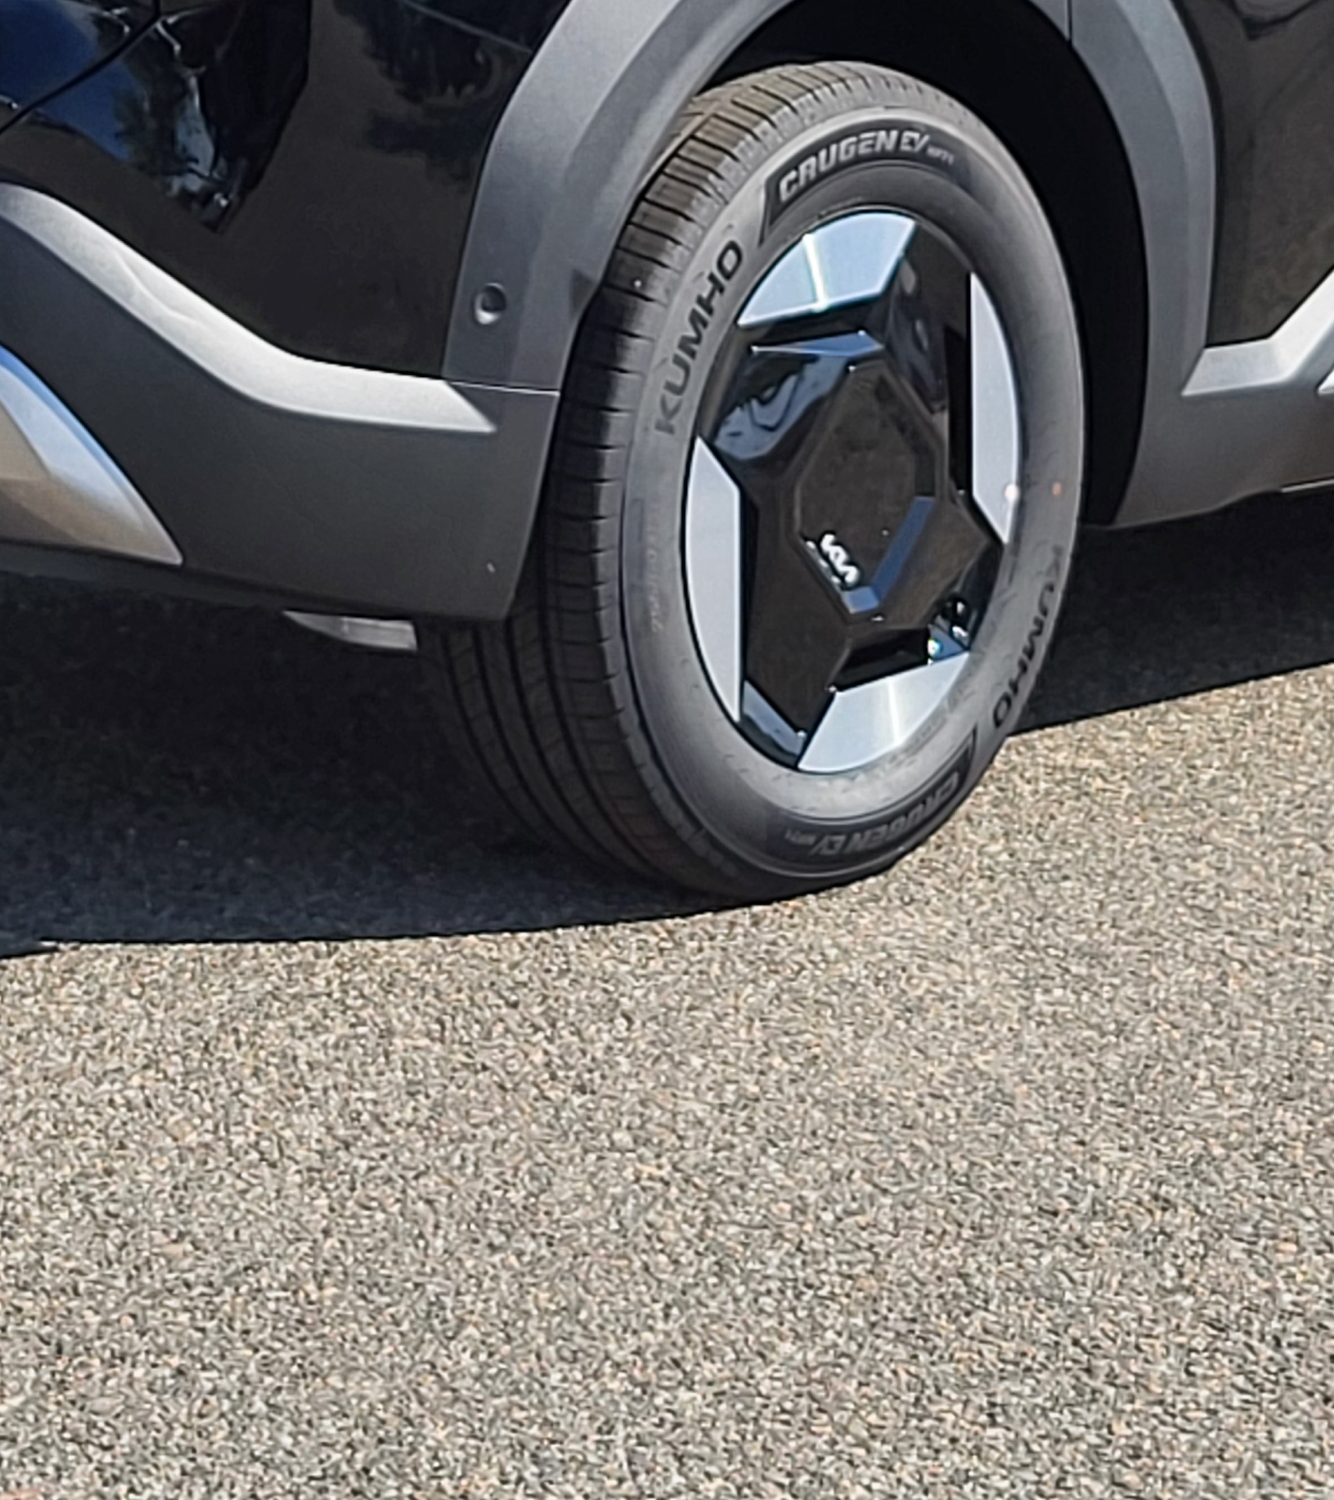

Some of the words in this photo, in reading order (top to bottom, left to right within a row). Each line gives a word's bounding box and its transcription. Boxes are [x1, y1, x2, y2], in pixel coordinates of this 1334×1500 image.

[779, 129, 898, 204] CRUGEN
[900, 130, 930, 152] EV
[654, 240, 743, 437] KUMHO
